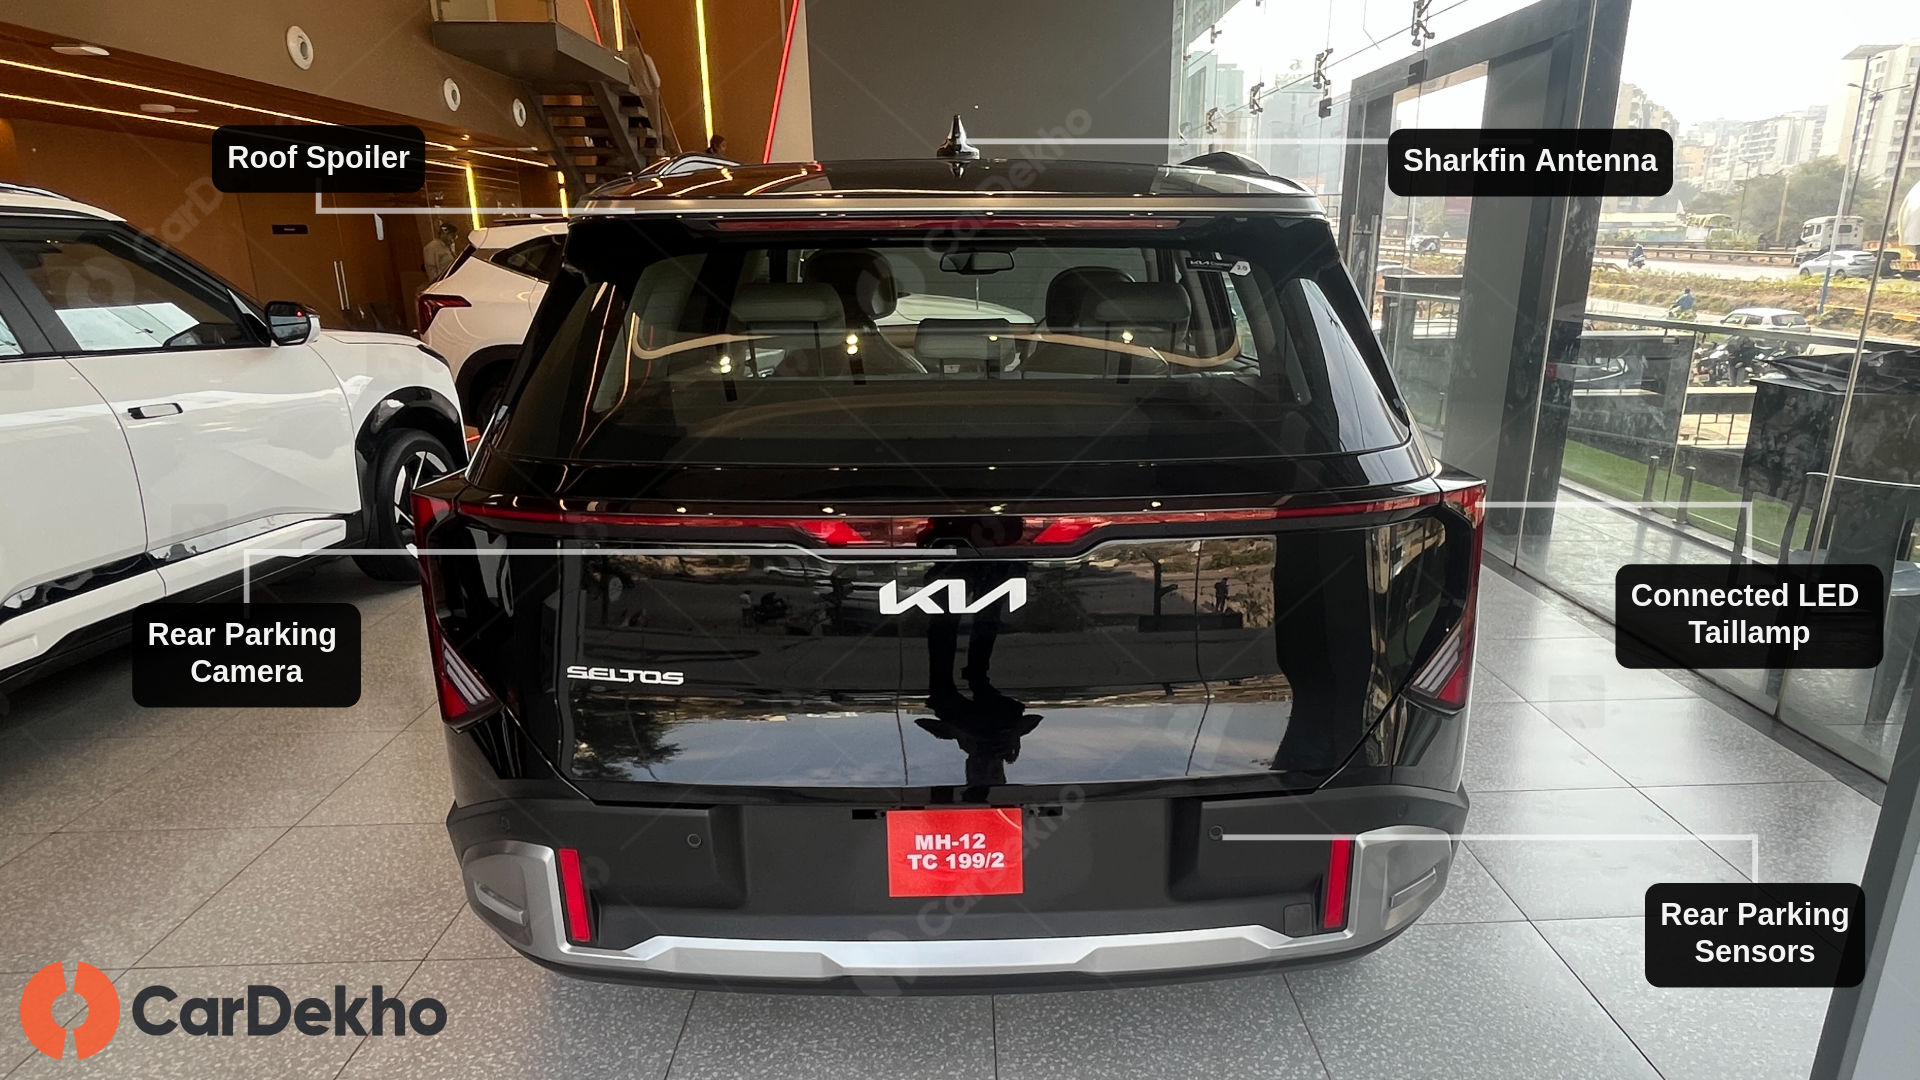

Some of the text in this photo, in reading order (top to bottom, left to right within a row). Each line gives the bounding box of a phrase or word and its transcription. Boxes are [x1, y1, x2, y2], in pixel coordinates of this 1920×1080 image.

[879, 578, 1027, 614] KIA
[567, 666, 683, 685] SELTOS
[916, 834, 985, 850] MH-12
[907, 852, 1004, 870] TC 199/2
